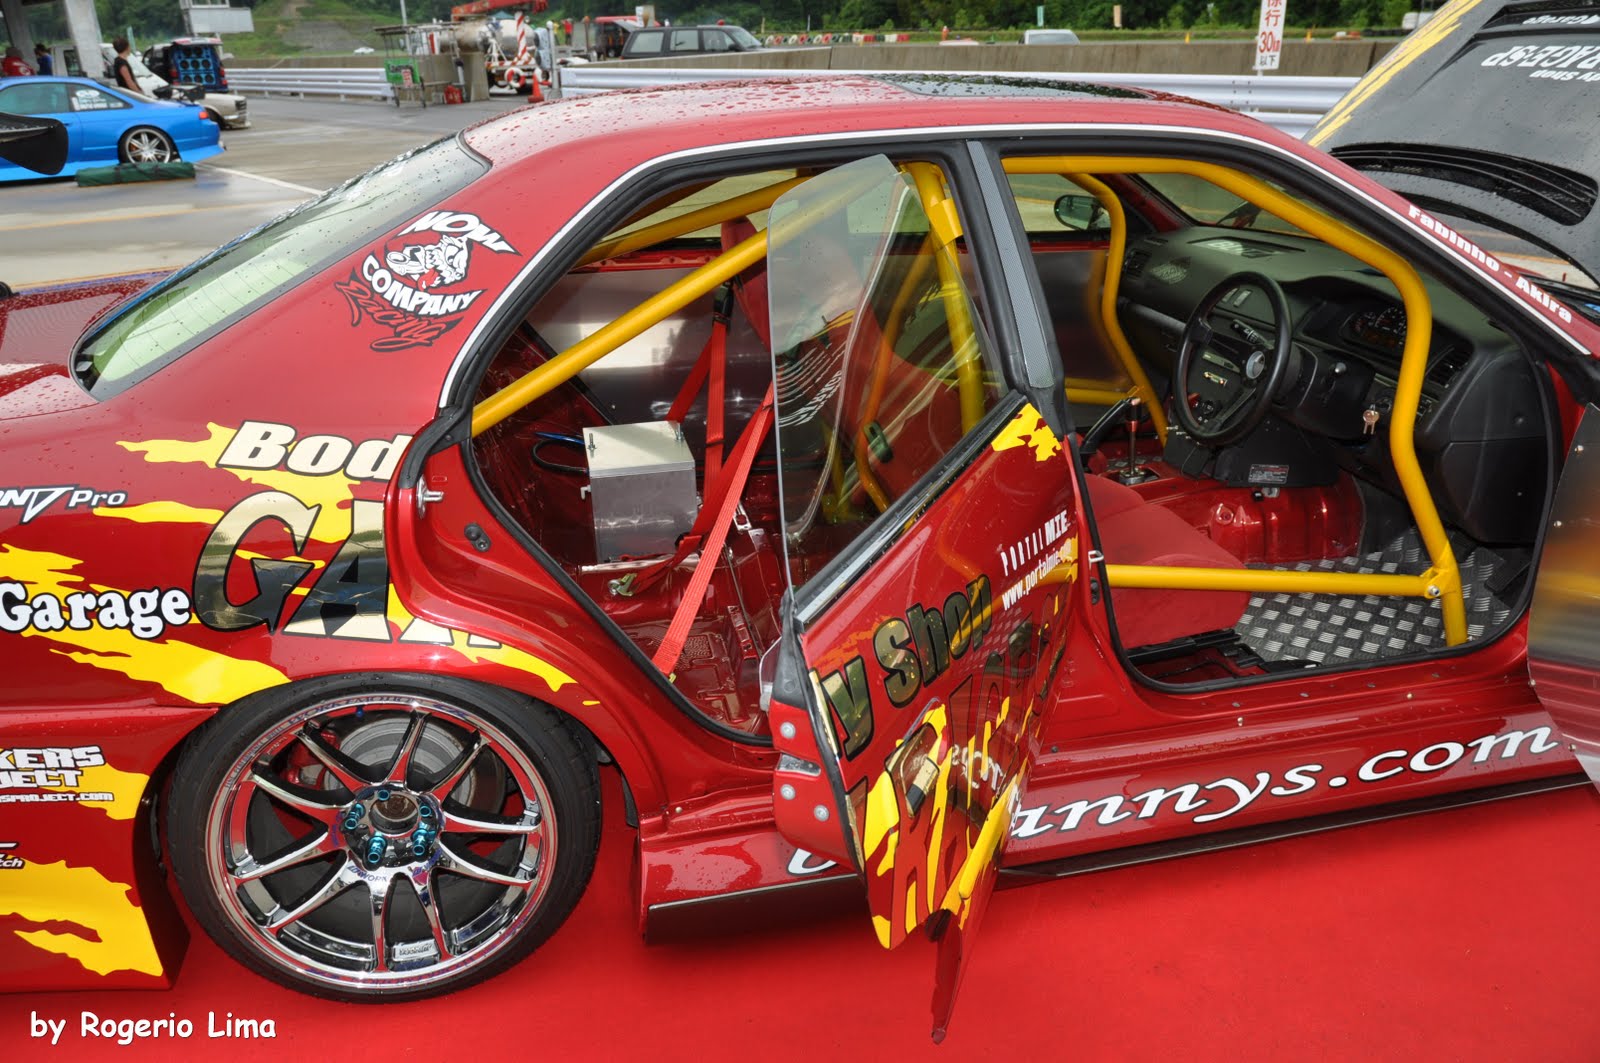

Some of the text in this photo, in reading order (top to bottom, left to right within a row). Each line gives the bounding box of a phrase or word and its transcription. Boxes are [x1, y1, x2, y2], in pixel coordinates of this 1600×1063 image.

[397, 210, 520, 255] NOW
[361, 253, 485, 317] COMPANY
[1408, 204, 1500, 272] Fabinho
[1515, 275, 1572, 324] Akira
[68, 488, 126, 508] Pro
[0, 582, 191, 638] Garage
[872, 574, 992, 708] Shop
